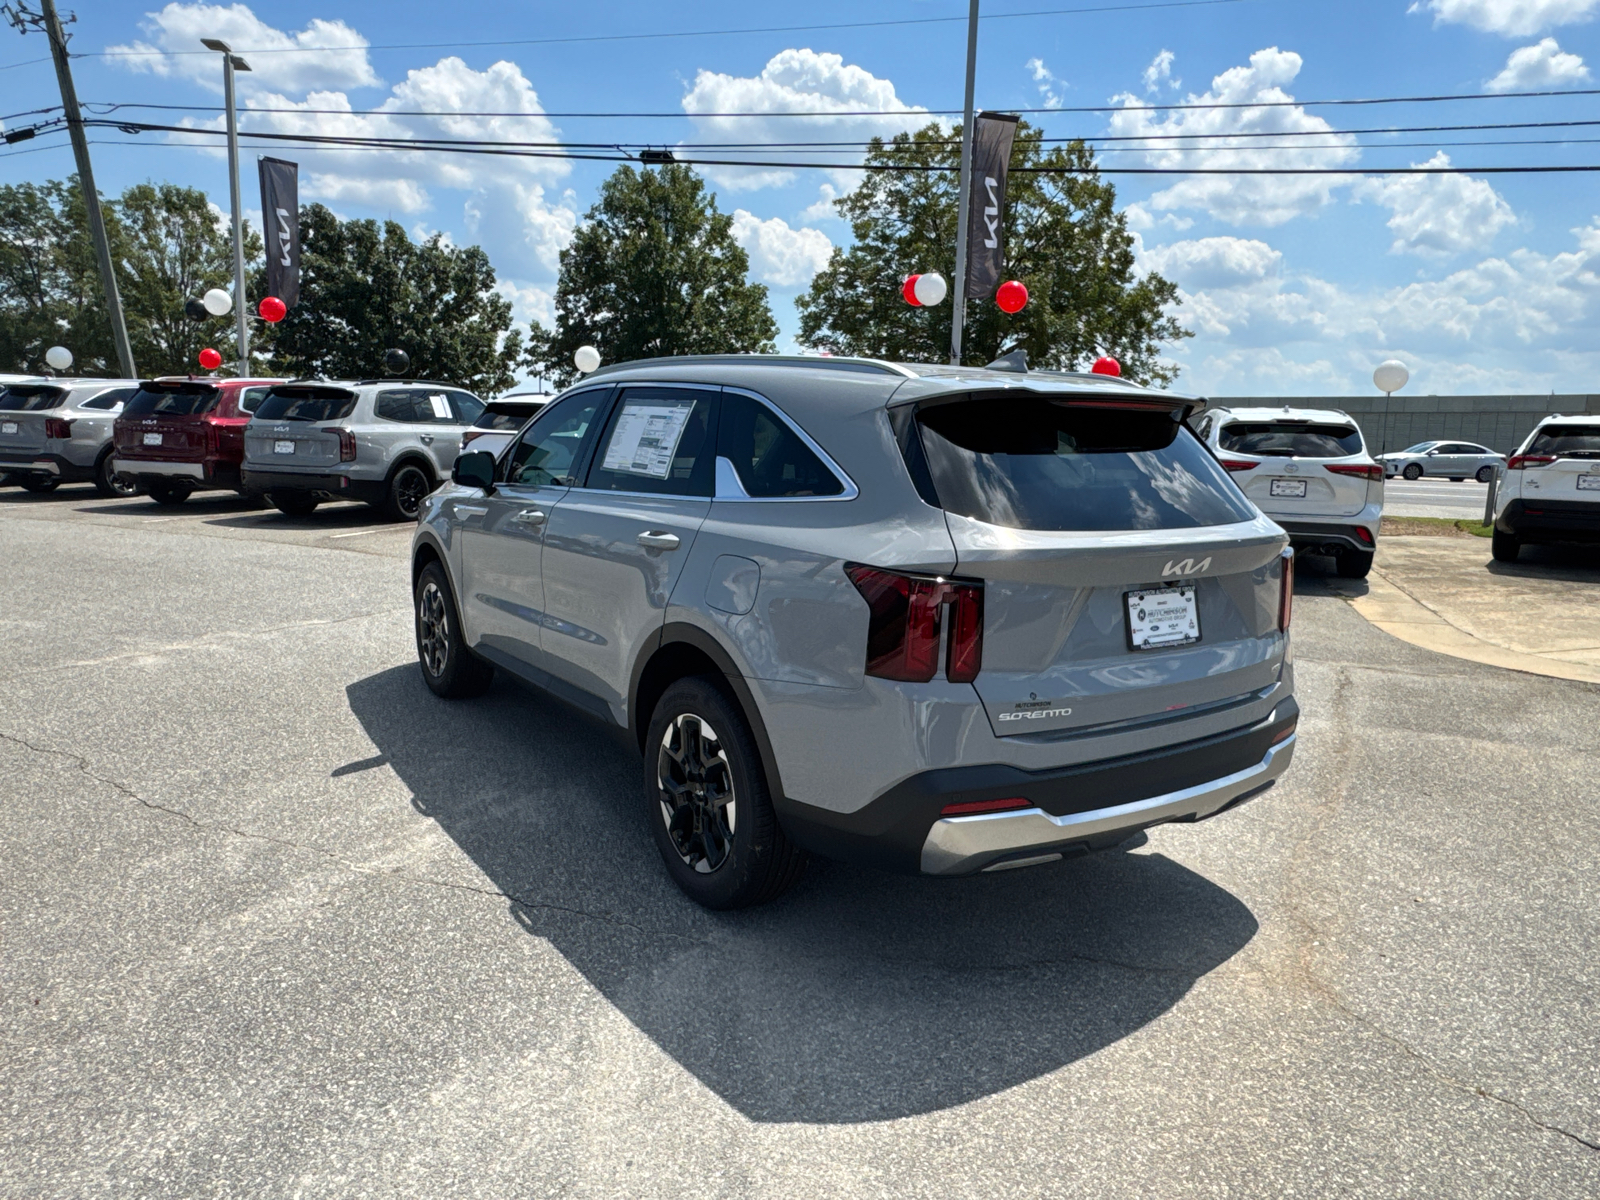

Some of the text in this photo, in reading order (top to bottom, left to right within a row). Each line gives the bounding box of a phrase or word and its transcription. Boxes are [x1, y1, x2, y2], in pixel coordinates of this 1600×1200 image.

[984, 176, 998, 249] KIA
[276, 207, 291, 267] KIA
[1161, 556, 1213, 577] KIA
[1147, 606, 1188, 618] HUTCHINSON
[1015, 701, 1052, 709] HUTCHINSON
[998, 708, 1072, 721] SORENTO
